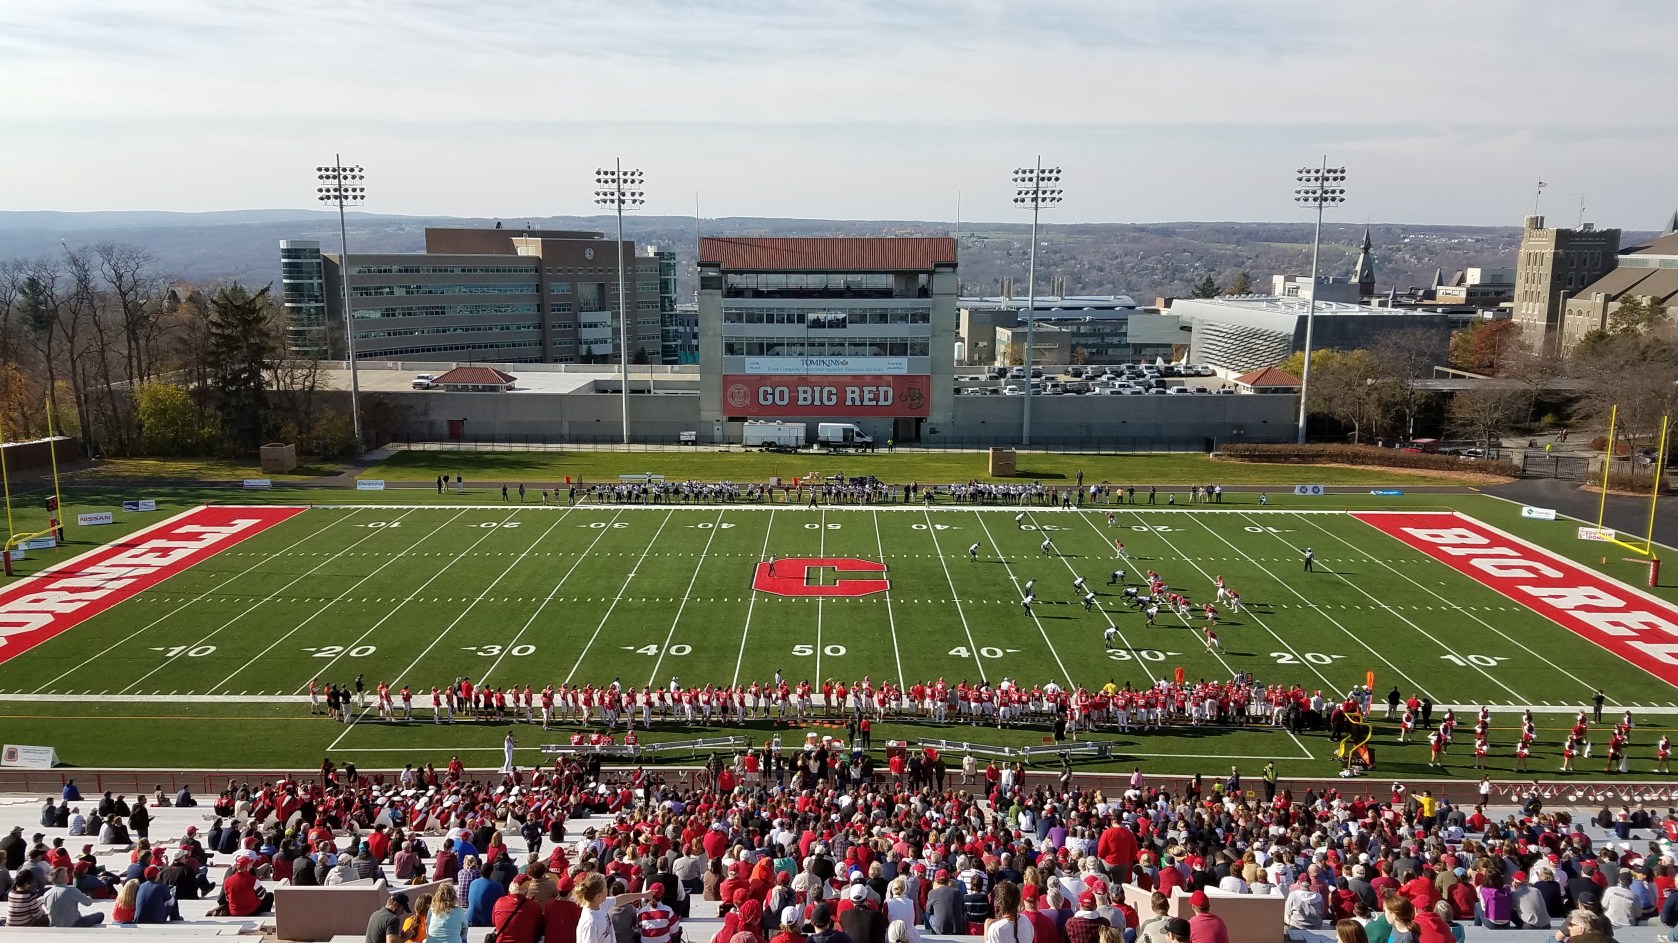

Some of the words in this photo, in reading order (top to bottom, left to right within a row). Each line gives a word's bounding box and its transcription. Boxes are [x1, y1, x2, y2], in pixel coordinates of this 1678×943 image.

[801, 359, 840, 367] TOMPKINS
[758, 386, 790, 406] GO
[797, 386, 837, 406] BIG
[845, 386, 893, 406] RED
[588, 521, 630, 529] 30
[1400, 527, 1564, 578] BIG
[0, 519, 263, 648] ORNELL
[165, 645, 217, 657] 10
[312, 645, 377, 657] 20
[476, 644, 537, 656] 30
[636, 644, 693, 655] 40
[791, 644, 847, 656] 50
[948, 646, 1003, 658] 40
[1105, 648, 1166, 661] 30
[1269, 652, 1333, 664] 20
[1440, 654, 1499, 667] 10
